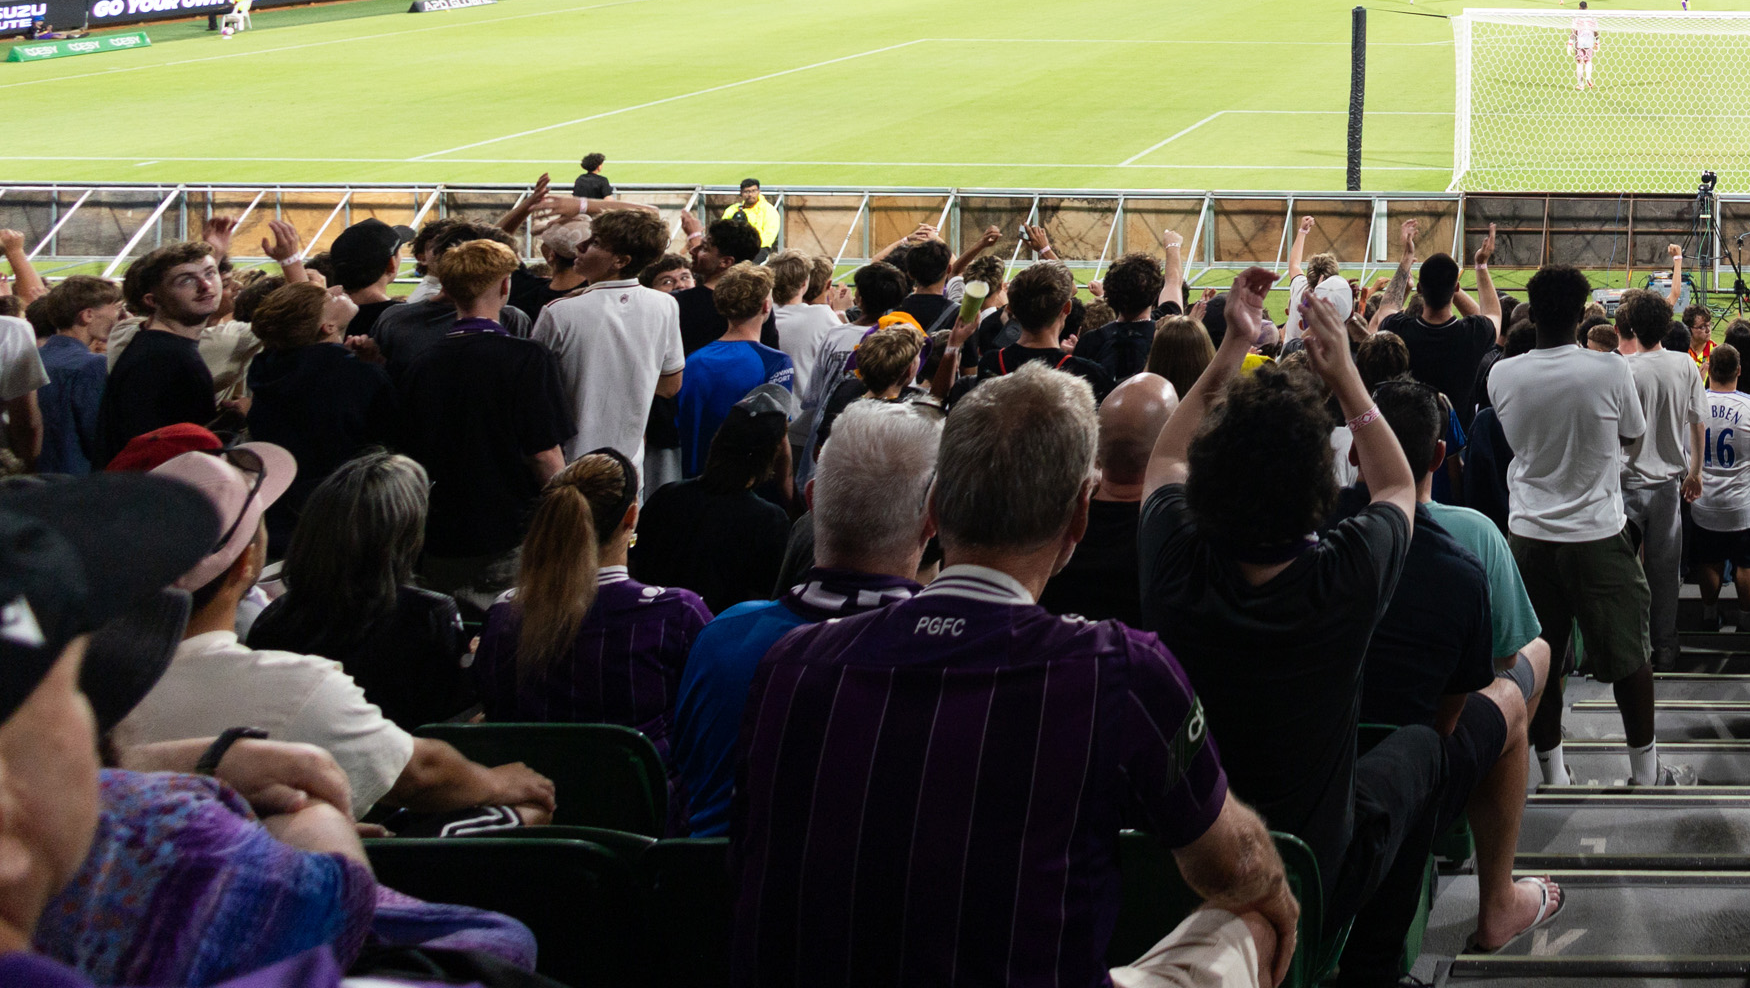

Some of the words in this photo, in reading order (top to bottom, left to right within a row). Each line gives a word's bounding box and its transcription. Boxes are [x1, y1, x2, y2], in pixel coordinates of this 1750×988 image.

[0, 2, 47, 20] UZU
[92, 0, 124, 18] GO
[423, 0, 449, 11] APD
[914, 616, 966, 637] PGFC
